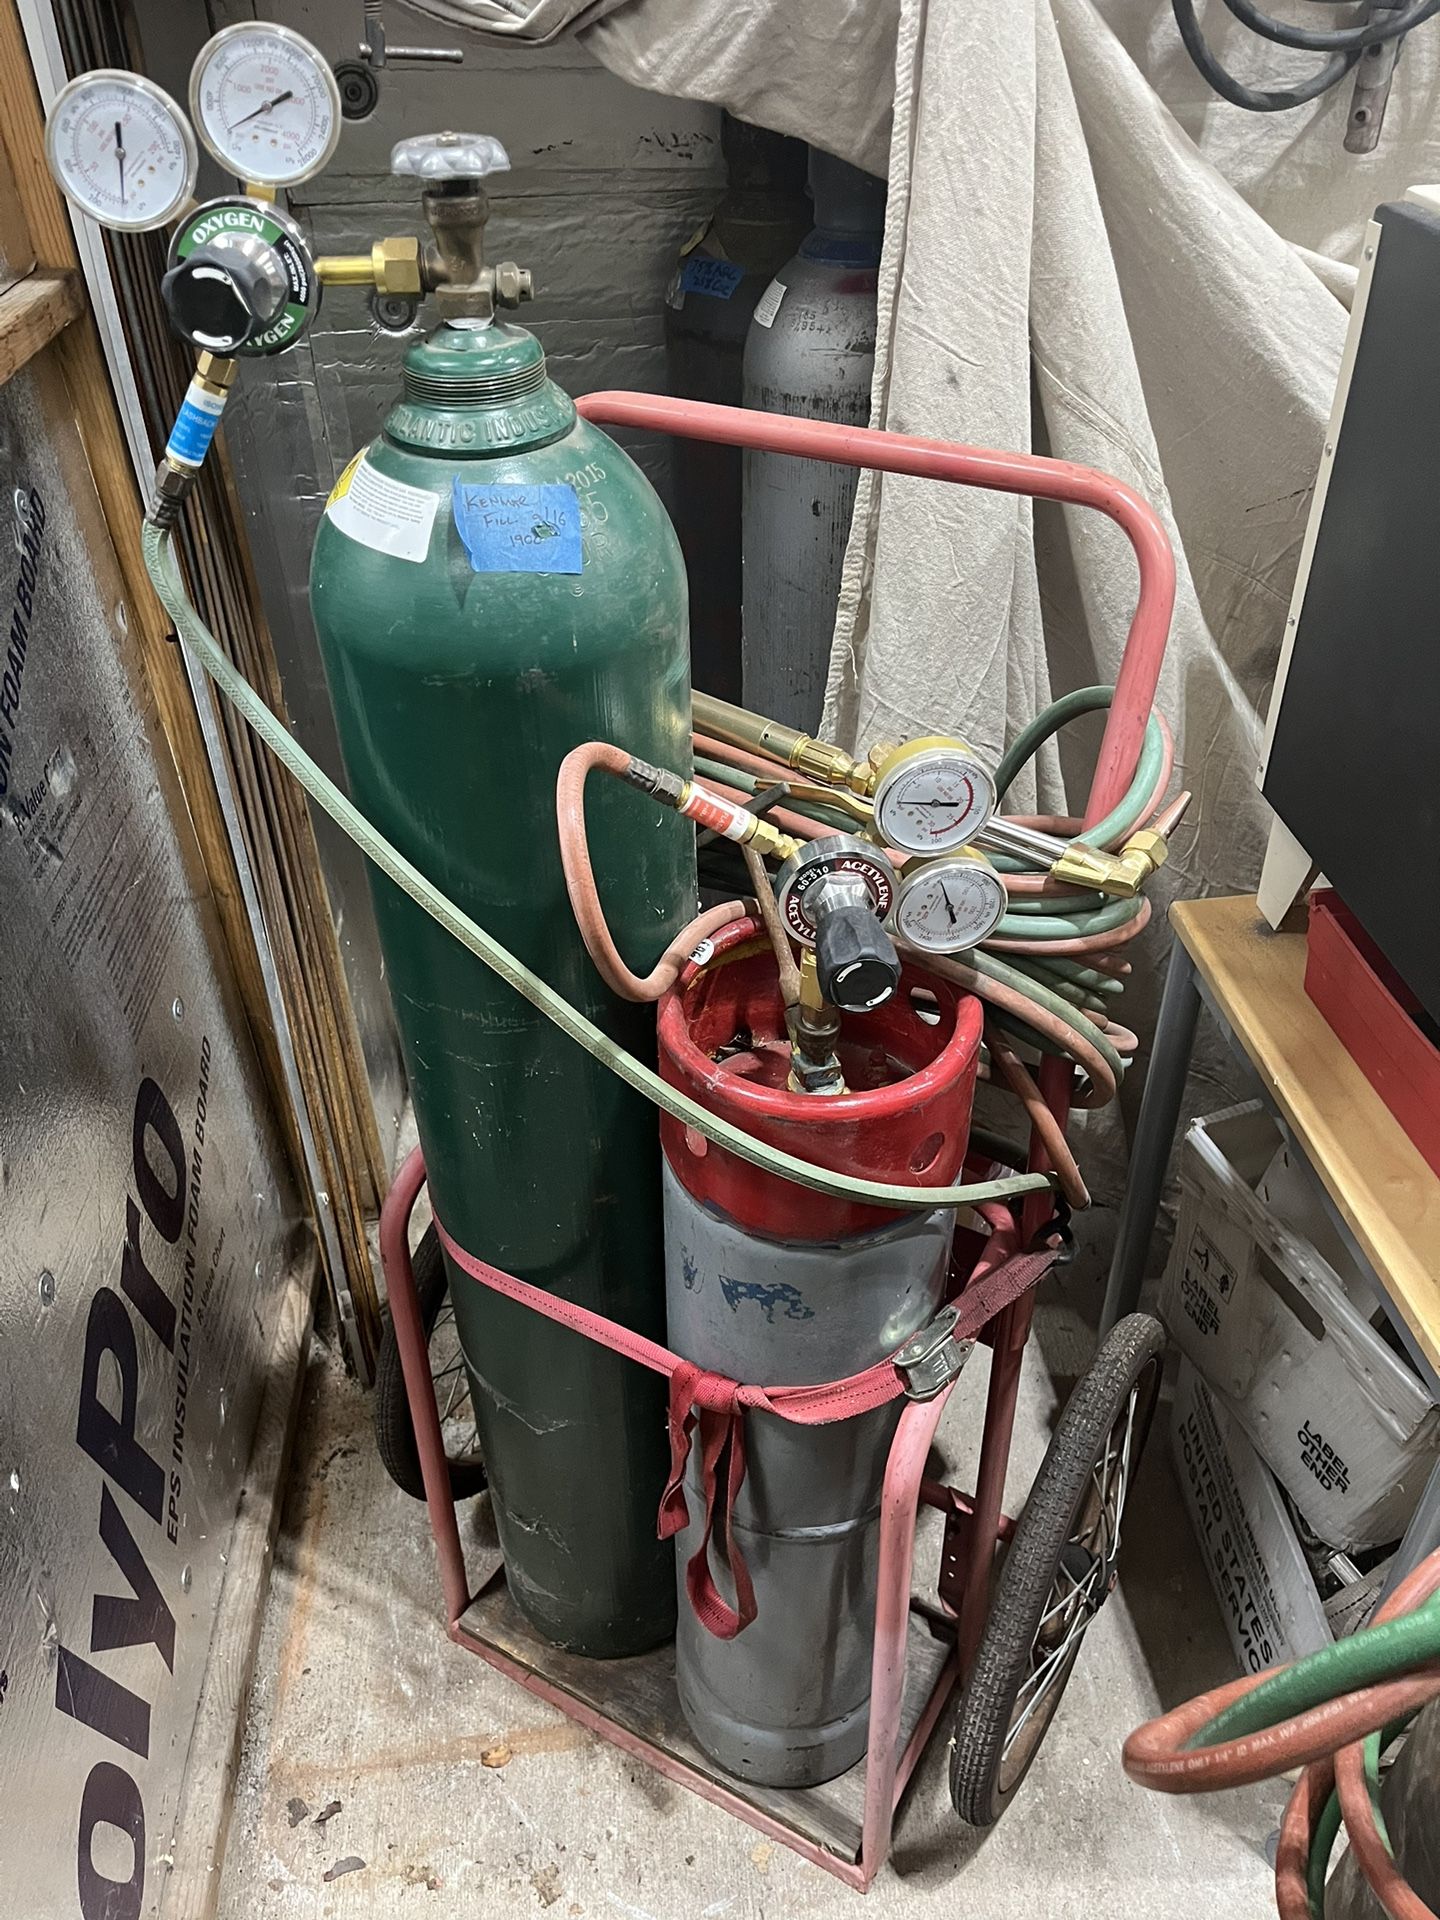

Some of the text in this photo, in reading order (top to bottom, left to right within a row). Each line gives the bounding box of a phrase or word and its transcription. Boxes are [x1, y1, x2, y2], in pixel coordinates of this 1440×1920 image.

[192, 212, 265, 244] OXYGEN
[246, 313, 296, 347] YGEN
[0, 607, 29, 729] FOAM
[797, 866, 829, 891] 60-510
[841, 860, 889, 909] ACETYLENE
[788, 895, 817, 940] ACETYL
[166, 1034, 212, 1545] EPS INSULATION FOAM BOARD
[1181, 1280, 1219, 1335] OTHER
[1185, 1268, 1221, 1323] LABEL
[1184, 1301, 1208, 1335] END
[1297, 1430, 1348, 1494] OTHER
[1301, 1450, 1332, 1491] END
[1303, 1420, 1351, 1485] LABEL
[1179, 1423, 1213, 1544] POSTAL
[1214, 1548, 1261, 1674] SERVIC
[1188, 1412, 1222, 1523] UNITED
[1221, 1530, 1273, 1665] STATES
[1252, 1735, 1276, 1751] MAX
